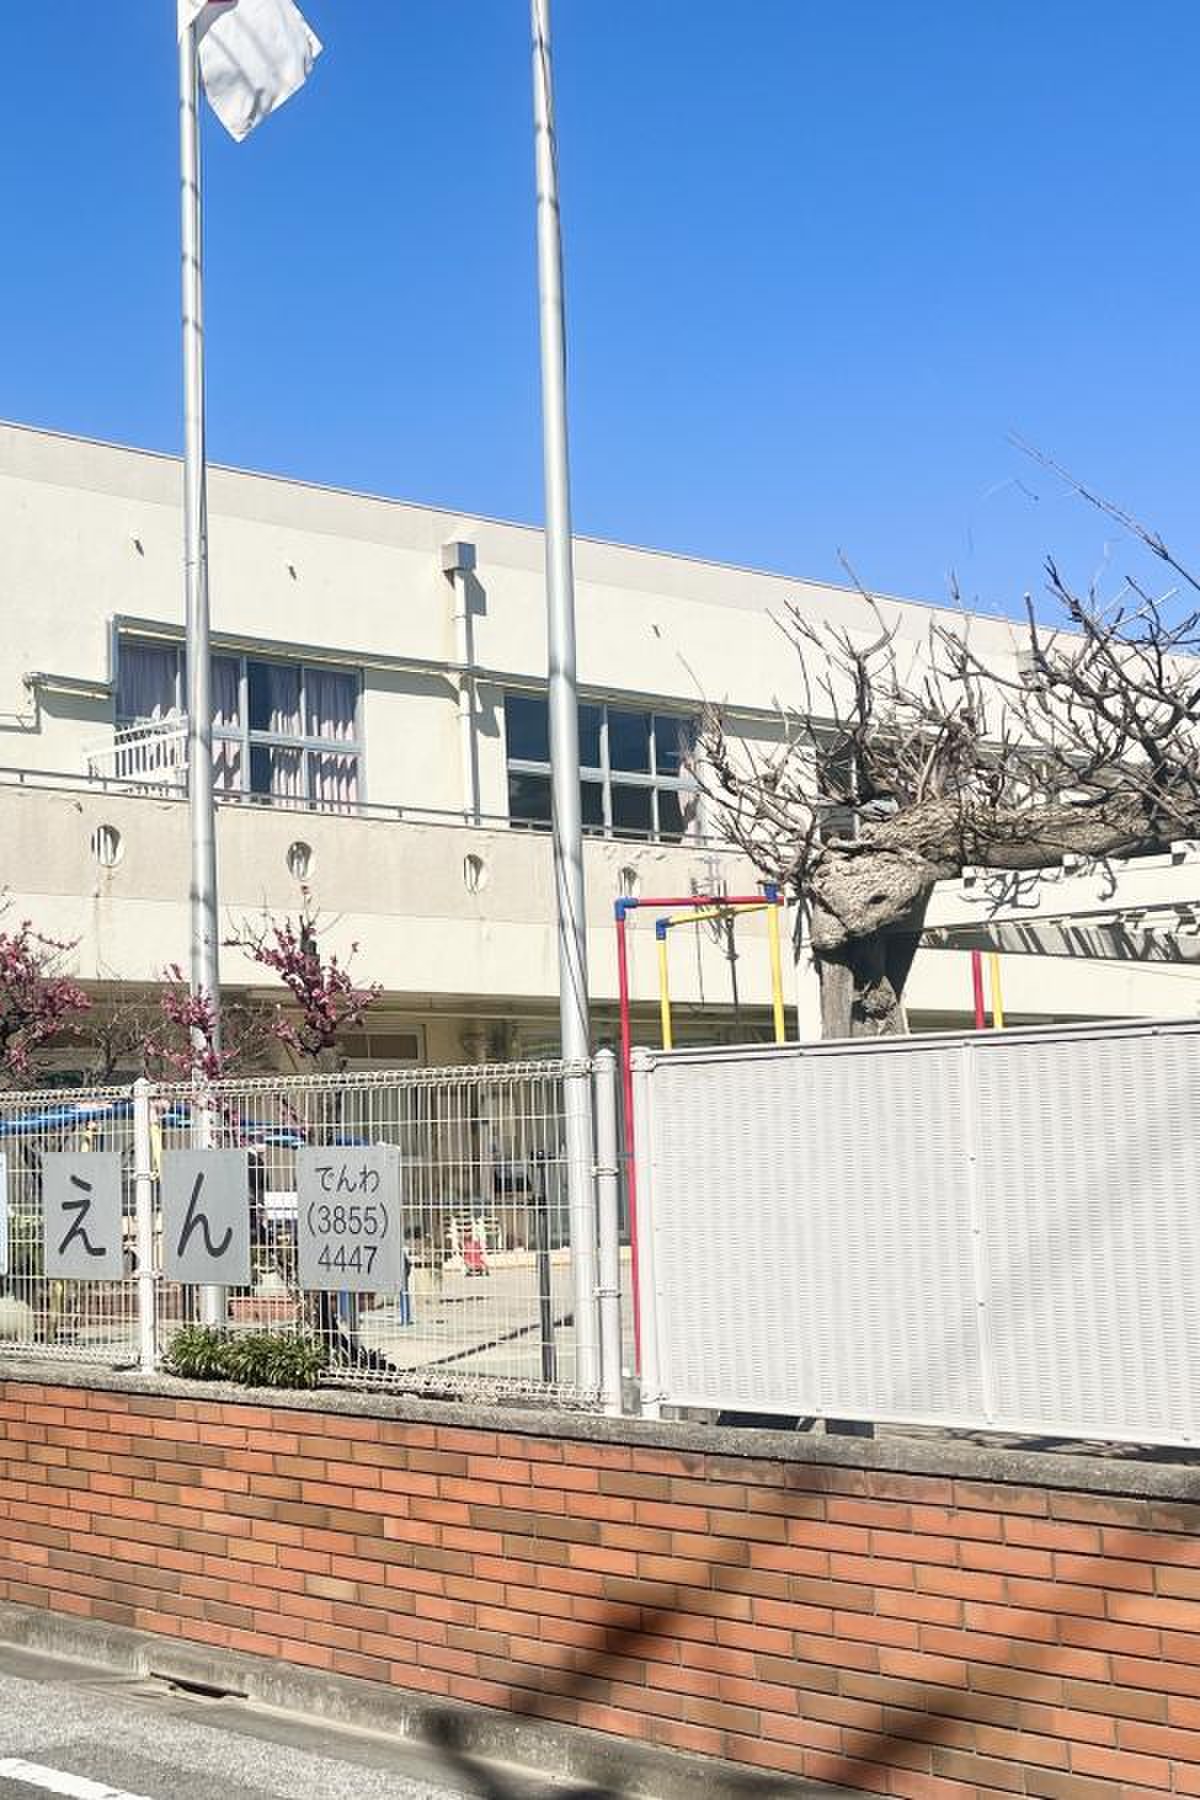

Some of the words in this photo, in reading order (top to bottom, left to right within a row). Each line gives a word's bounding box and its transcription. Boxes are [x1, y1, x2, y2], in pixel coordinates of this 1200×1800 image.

[315, 1165, 381, 1193] でんわ
[306, 1201, 389, 1238] (3855)
[317, 1245, 379, 1274] 4447
